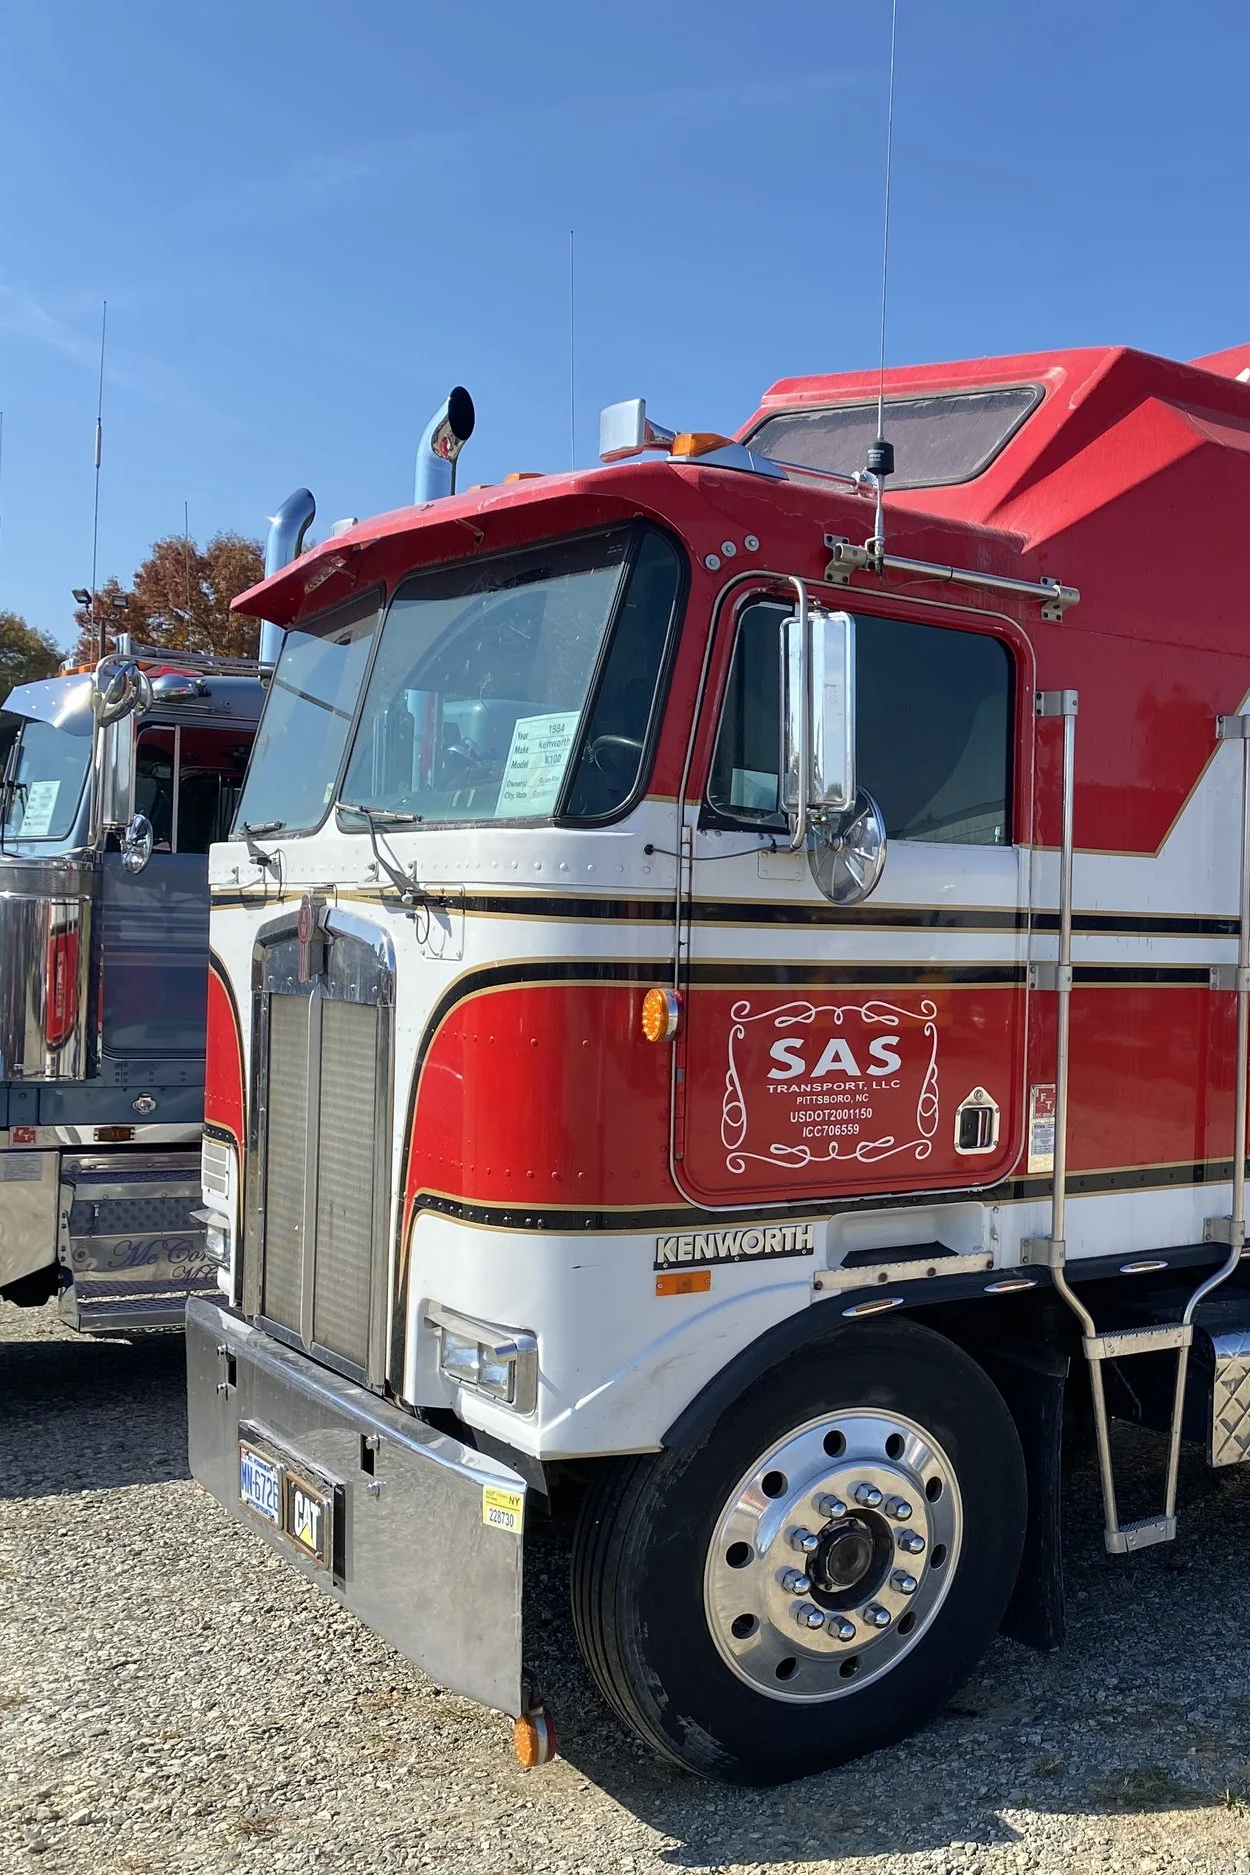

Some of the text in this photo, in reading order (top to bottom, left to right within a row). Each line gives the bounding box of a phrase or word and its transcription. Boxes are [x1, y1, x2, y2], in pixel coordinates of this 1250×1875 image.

[549, 724, 565, 733] 1984
[518, 732, 528, 740] Year
[514, 746, 529, 754] Make
[538, 738, 570, 749] Kenworth
[511, 760, 529, 769] Model
[545, 754, 562, 764] K100
[767, 1035, 902, 1080] SAS
[767, 1080, 901, 1094] TRANSPORT, LLC
[796, 1093, 869, 1106] PITTSBORO, NC
[790, 1108, 873, 1122] USDOT2001150
[802, 1123, 860, 1138] ICC706559
[656, 1224, 814, 1264] KENWORTH
[508, 1496, 520, 1506] NY
[294, 1491, 320, 1550] CAT
[489, 1508, 514, 1528] 228730
